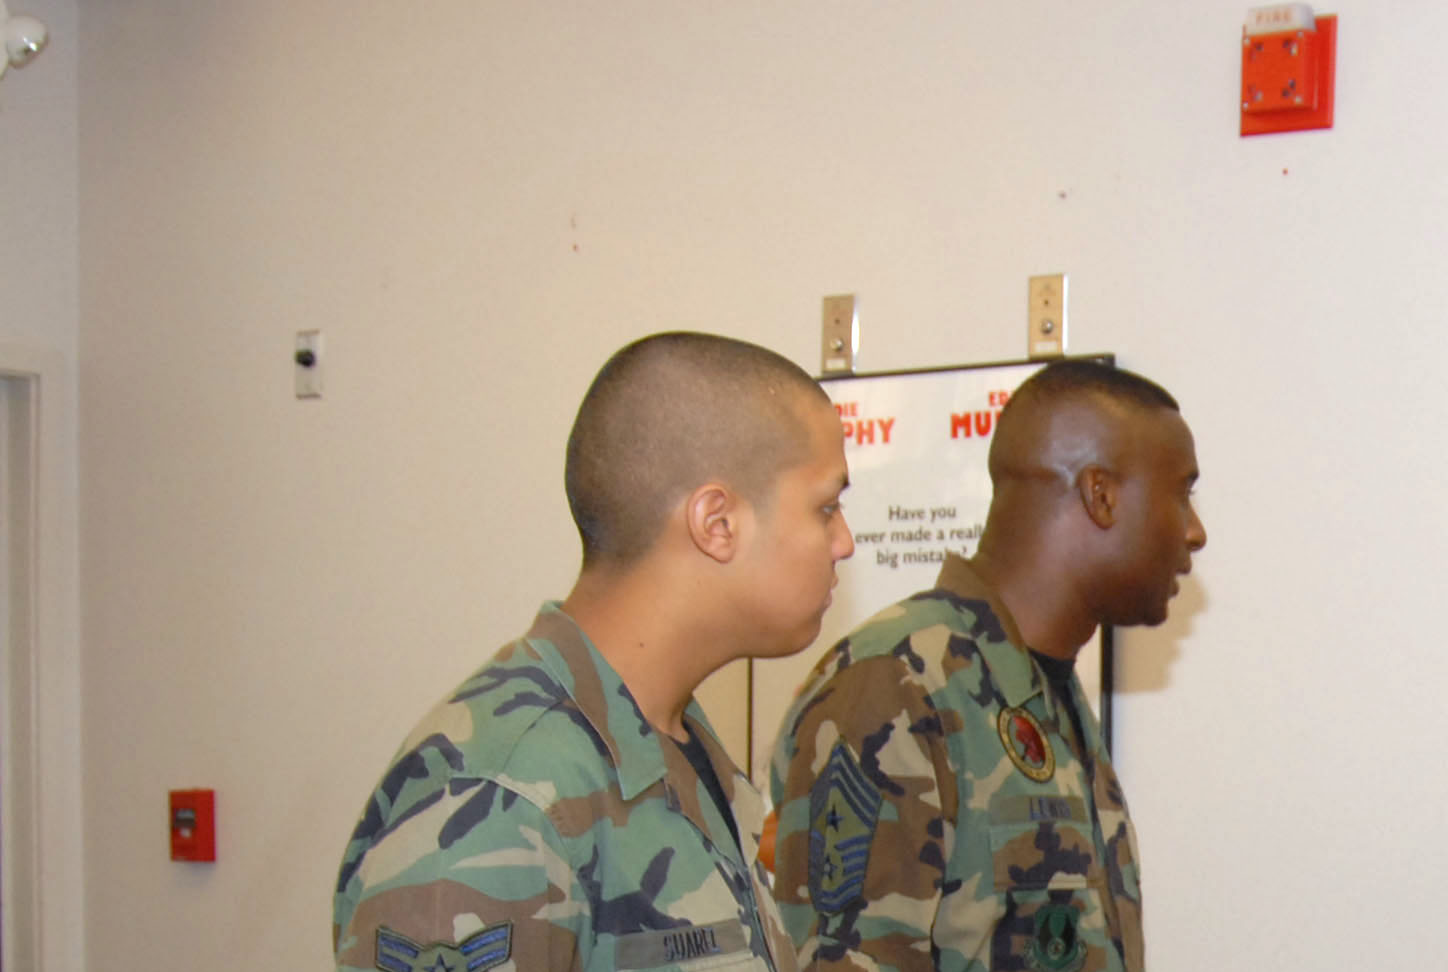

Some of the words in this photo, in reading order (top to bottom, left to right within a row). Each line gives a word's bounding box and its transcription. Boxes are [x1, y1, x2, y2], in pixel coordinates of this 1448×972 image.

[841, 417, 896, 446] PHY
[887, 504, 926, 521] Have
[930, 506, 957, 523] you
[855, 531, 885, 544] ever
[890, 526, 931, 543] made
[936, 529, 945, 541] a
[949, 523, 982, 540] reall
[876, 547, 899, 569] big
